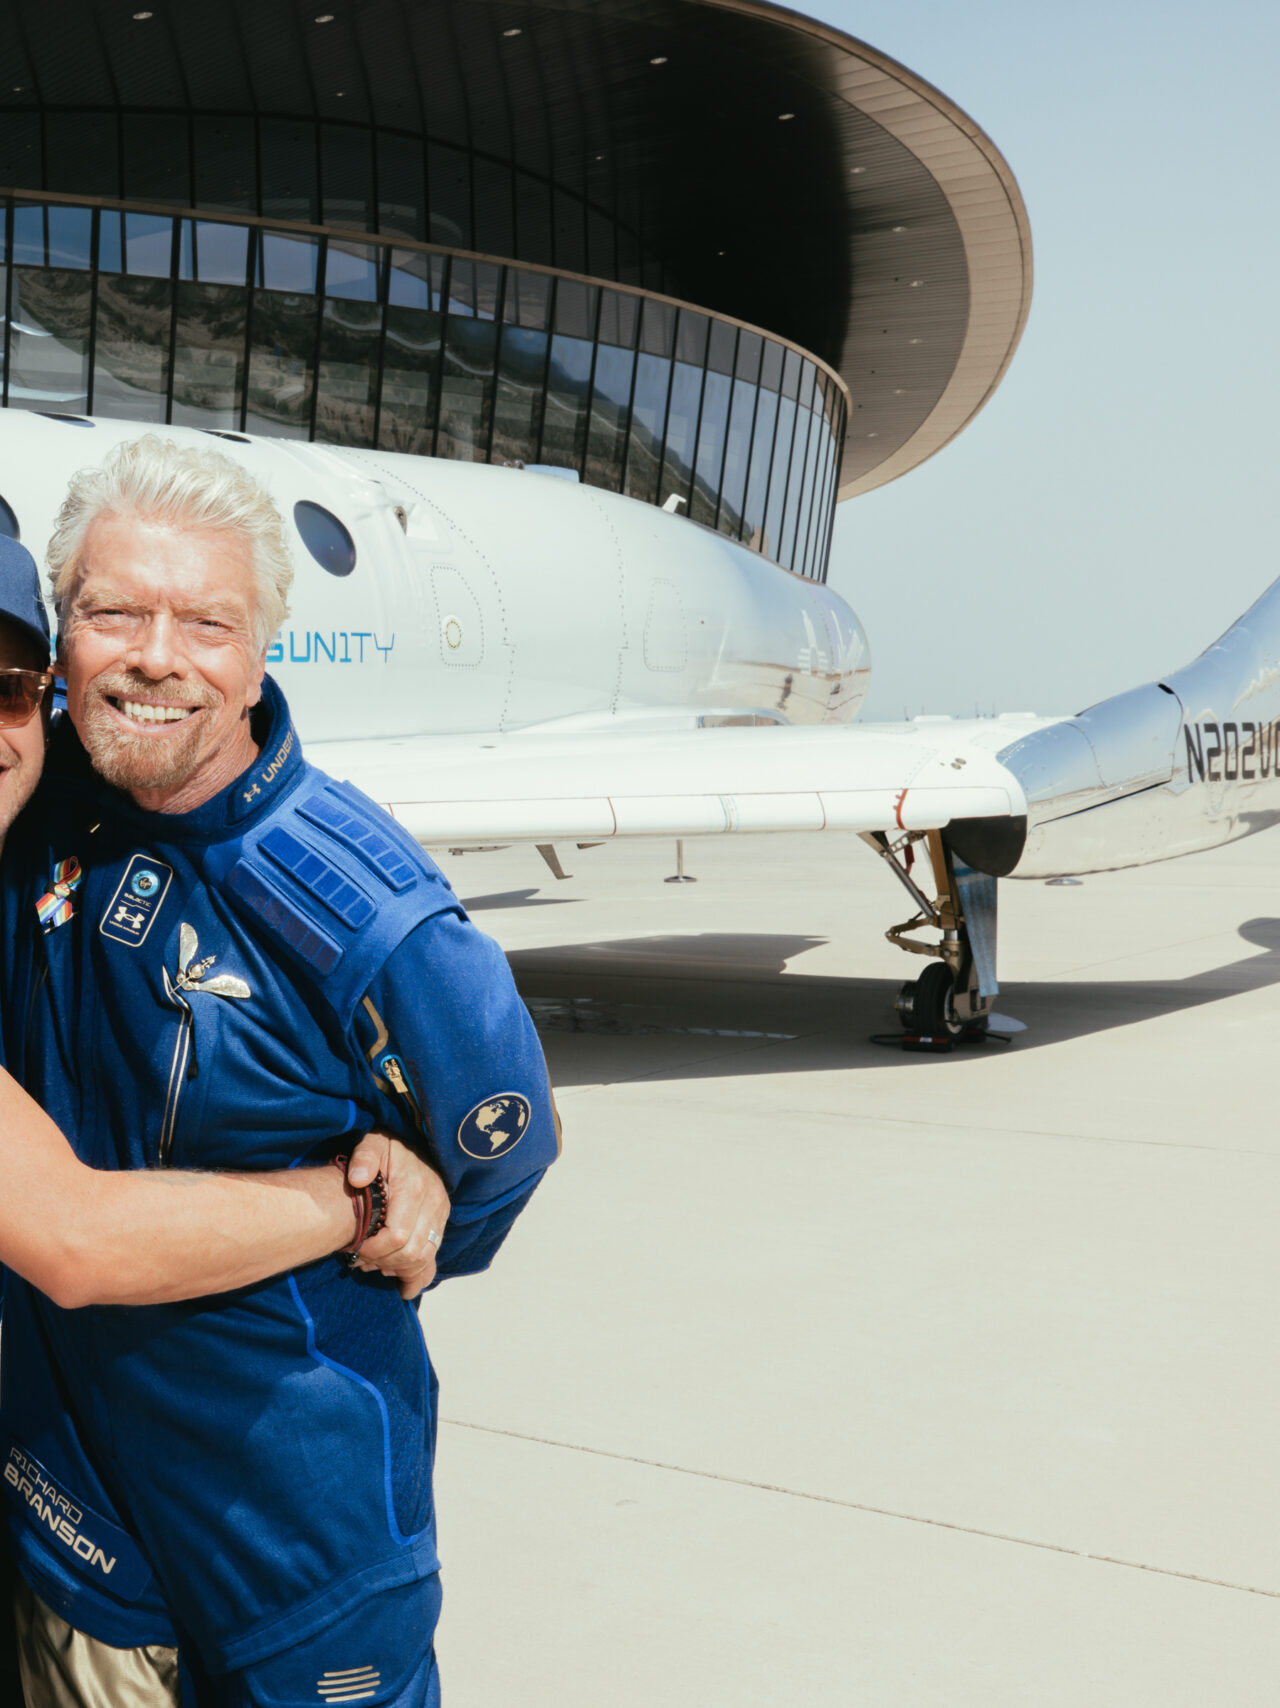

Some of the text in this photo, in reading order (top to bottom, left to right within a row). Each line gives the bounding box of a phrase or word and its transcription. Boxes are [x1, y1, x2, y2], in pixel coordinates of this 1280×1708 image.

[261, 731, 293, 783] UNDER
[3, 1462, 117, 1574] BRANSON
[9, 1447, 83, 1525] RICHARD
